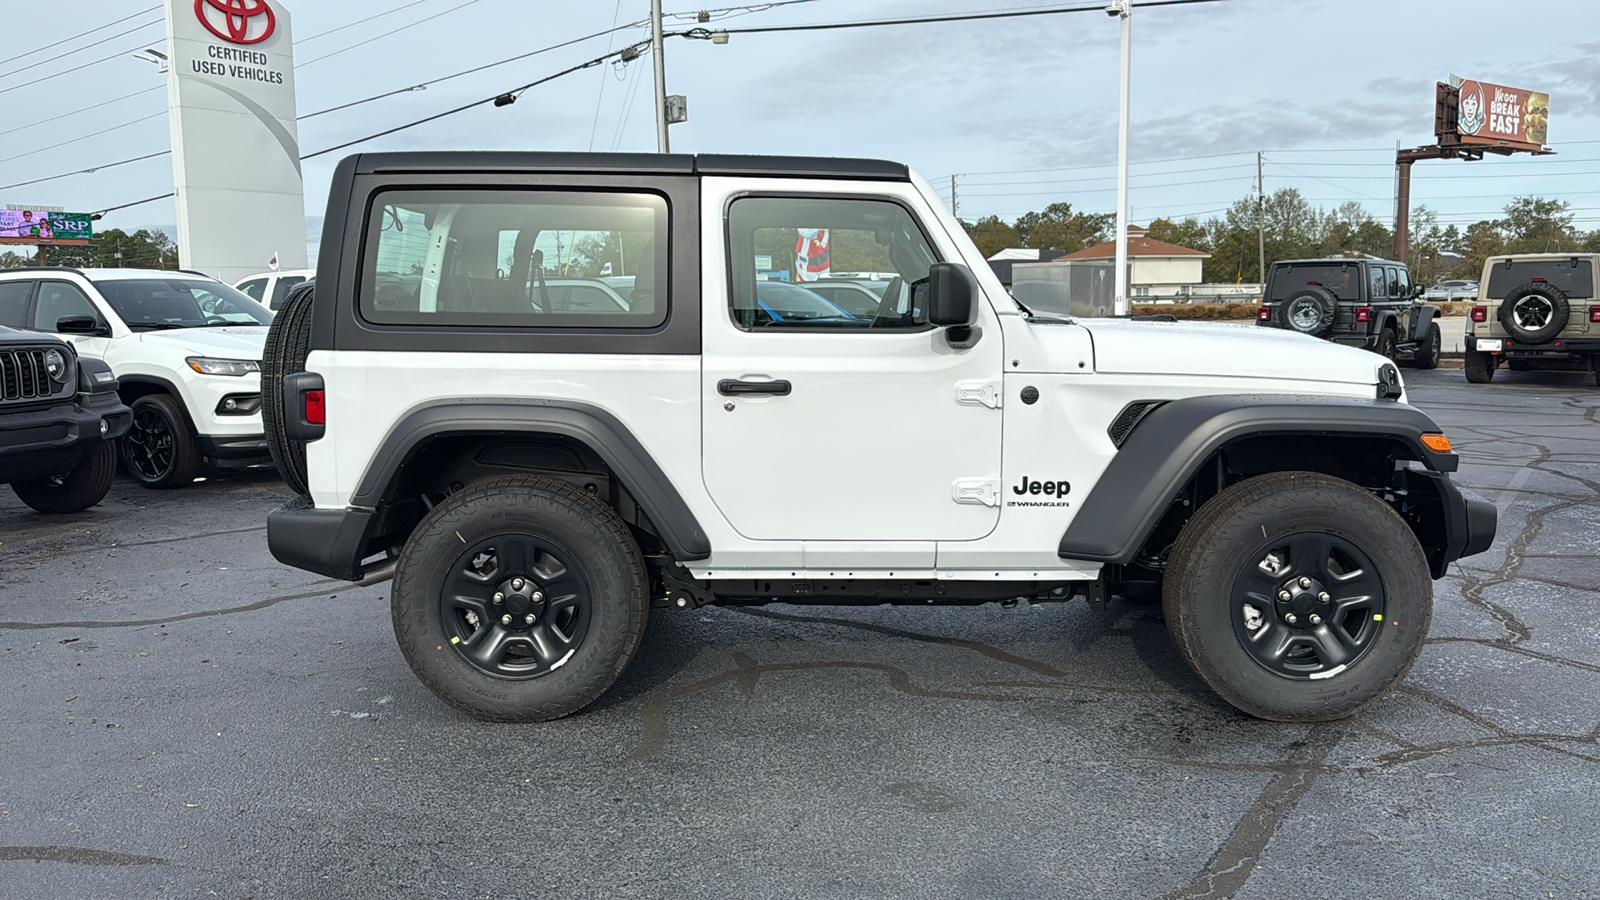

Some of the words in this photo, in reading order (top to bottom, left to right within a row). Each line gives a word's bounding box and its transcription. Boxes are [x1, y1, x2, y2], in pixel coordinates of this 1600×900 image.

[208, 45, 267, 66] CERTIFIED
[192, 59, 226, 76] USED
[229, 65, 283, 84] VEHICLES
[1504, 92, 1518, 104] GOT
[1490, 100, 1520, 118] BREAK
[1490, 113, 1520, 135] FAST
[53, 220, 89, 231] SRP
[1013, 476, 1071, 499] Jeep
